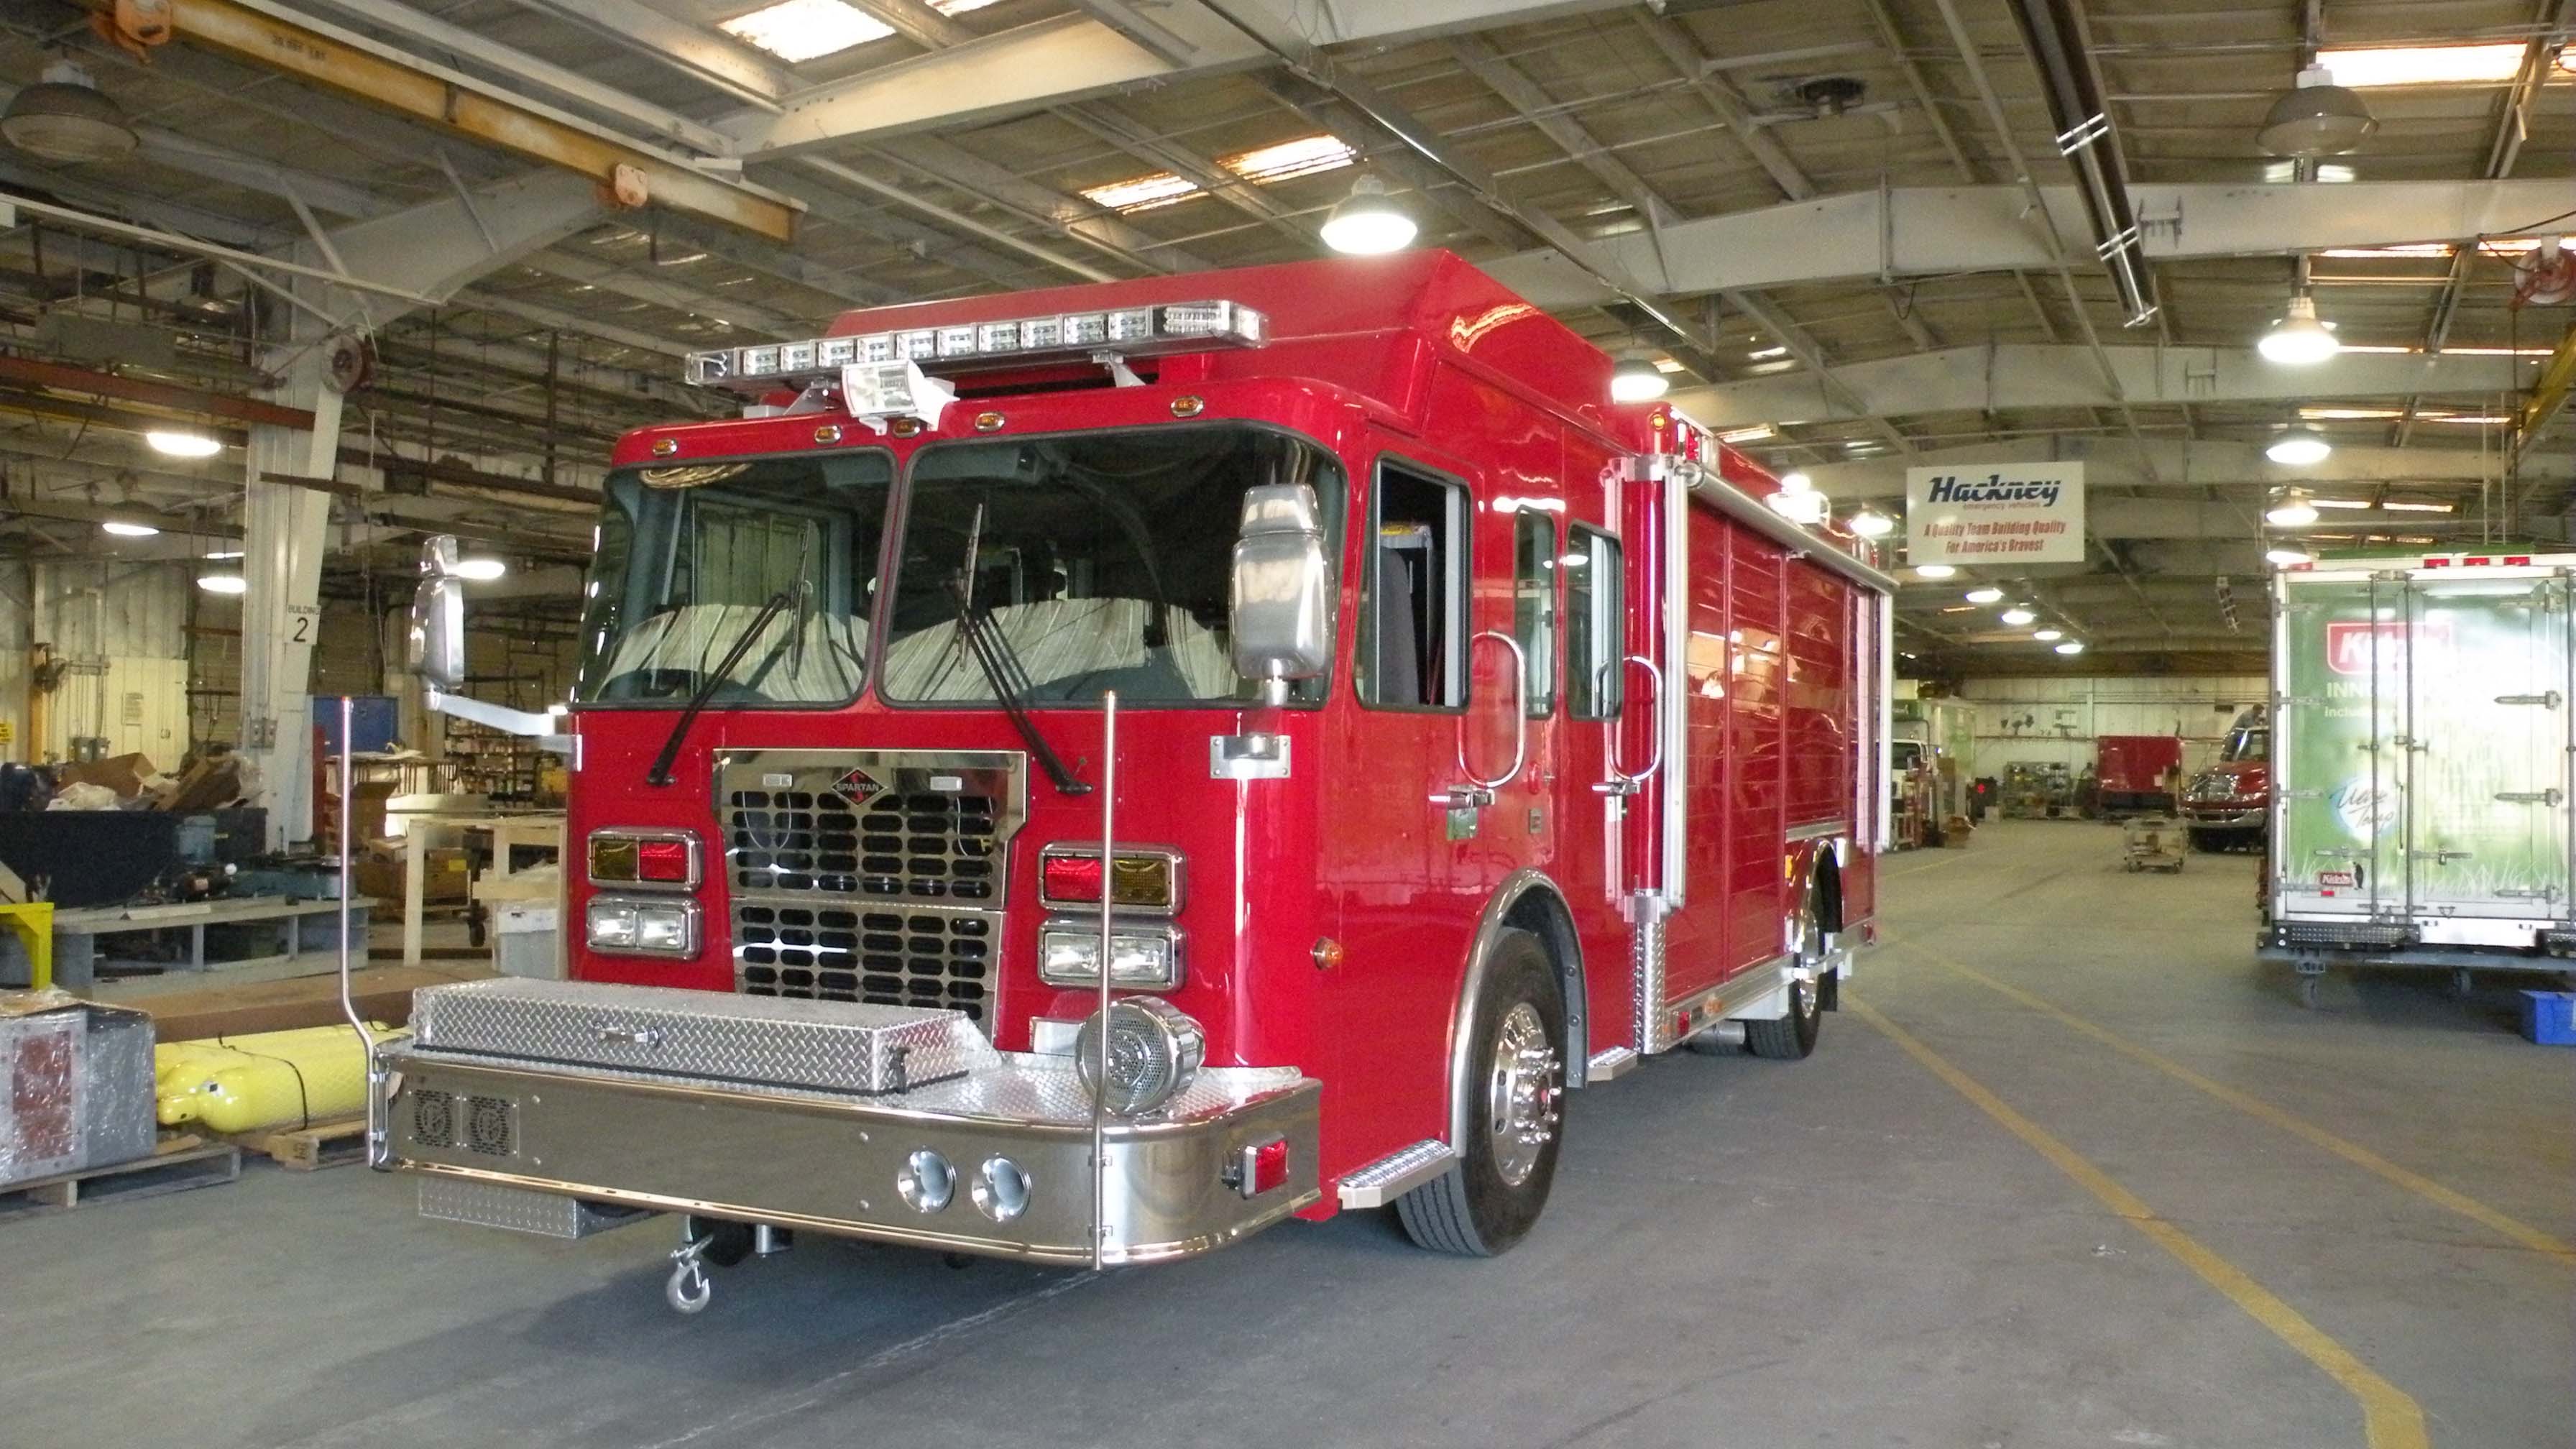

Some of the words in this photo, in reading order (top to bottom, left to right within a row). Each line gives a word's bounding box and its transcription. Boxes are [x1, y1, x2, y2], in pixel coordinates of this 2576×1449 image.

[1928, 474, 2061, 507] Hackney
[1923, 524, 1931, 537] A
[1932, 523, 1964, 538] Quality
[1967, 523, 1990, 536] Team
[1990, 522, 2030, 536] Building
[2032, 520, 2066, 535] Quality
[1945, 541, 1960, 553] For
[1961, 540, 2007, 553] America's
[2008, 539, 2044, 552] Bravest
[293, 617, 308, 643] 2
[836, 783, 880, 791] SPARTAN
